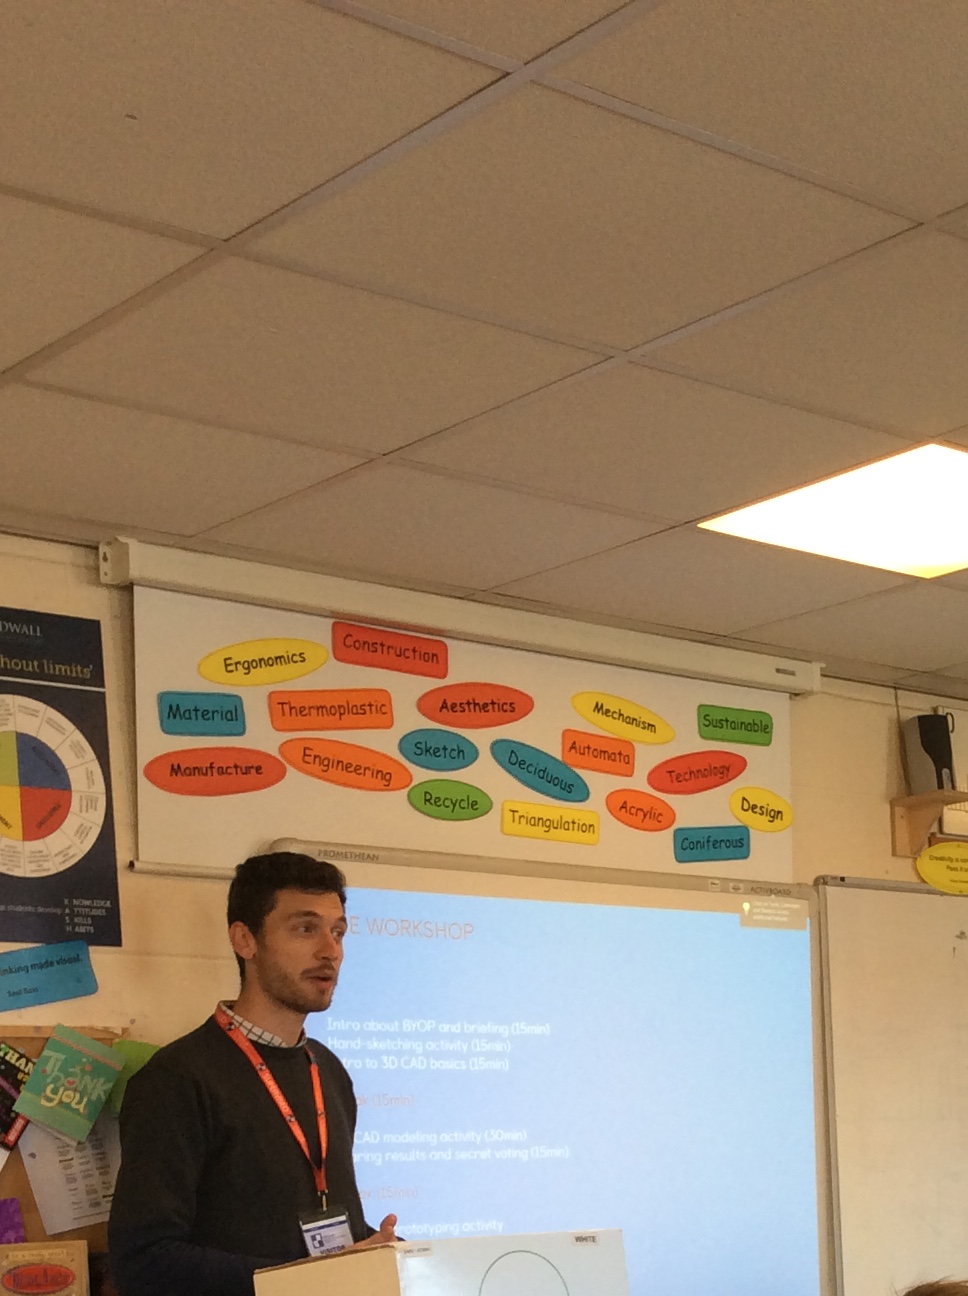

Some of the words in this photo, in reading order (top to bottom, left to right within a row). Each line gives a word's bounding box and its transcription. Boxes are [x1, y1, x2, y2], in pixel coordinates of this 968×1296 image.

[342, 635, 440, 664] Construction
[223, 650, 307, 675] Ergonomics
[167, 703, 239, 723] Material
[277, 700, 388, 720] Thermoplastic
[438, 698, 516, 713] Aesthetics
[592, 701, 657, 734] Mechanism
[702, 713, 770, 734] Sustainable
[413, 741, 466, 761] Sketch
[567, 740, 631, 765] Automata
[169, 762, 264, 778] Manufacture
[301, 746, 393, 786] Engineering
[507, 750, 575, 795] Deciduous
[666, 762, 732, 785] Technology
[423, 790, 480, 813] Recycle
[740, 796, 784, 822] Design
[508, 809, 596, 835] Triangulation
[618, 800, 664, 824] Acrylic
[680, 835, 745, 852] Coniferous
[318, 848, 380, 861] PROMETHEAN
[366, 917, 475, 940] WORKSHOP
[327, 1017, 360, 1031] Intro
[362, 1019, 399, 1032] about
[402, 1018, 436, 1032] BYOP
[438, 1021, 461, 1033] and
[463, 1020, 509, 1037] briefing
[511, 1021, 550, 1036] (15min)
[327, 1036, 424, 1054] Hand-sketching
[425, 1038, 469, 1054] activity
[471, 1038, 512, 1053] (15min)
[342, 1056, 362, 1069] tro
[365, 1057, 378, 1069] to
[380, 1055, 398, 1069] 3D
[400, 1056, 427, 1069] CAD
[429, 1057, 467, 1070] basics
[469, 1056, 510, 1071] (15min)
[41, 1083, 88, 1113] you
[354, 1130, 380, 1144] CAD
[383, 1130, 437, 1146] modeling
[439, 1130, 482, 1145] activity
[484, 1128, 527, 1143] (30min)
[385, 1148, 427, 1161] results
[429, 1147, 453, 1160] and
[455, 1148, 492, 1160] secret
[494, 1148, 529, 1161] voting
[530, 1145, 569, 1158] (15min)
[399, 1221, 460, 1236] rototyping
[462, 1219, 503, 1233] activity
[574, 1235, 597, 1243] WHITE
